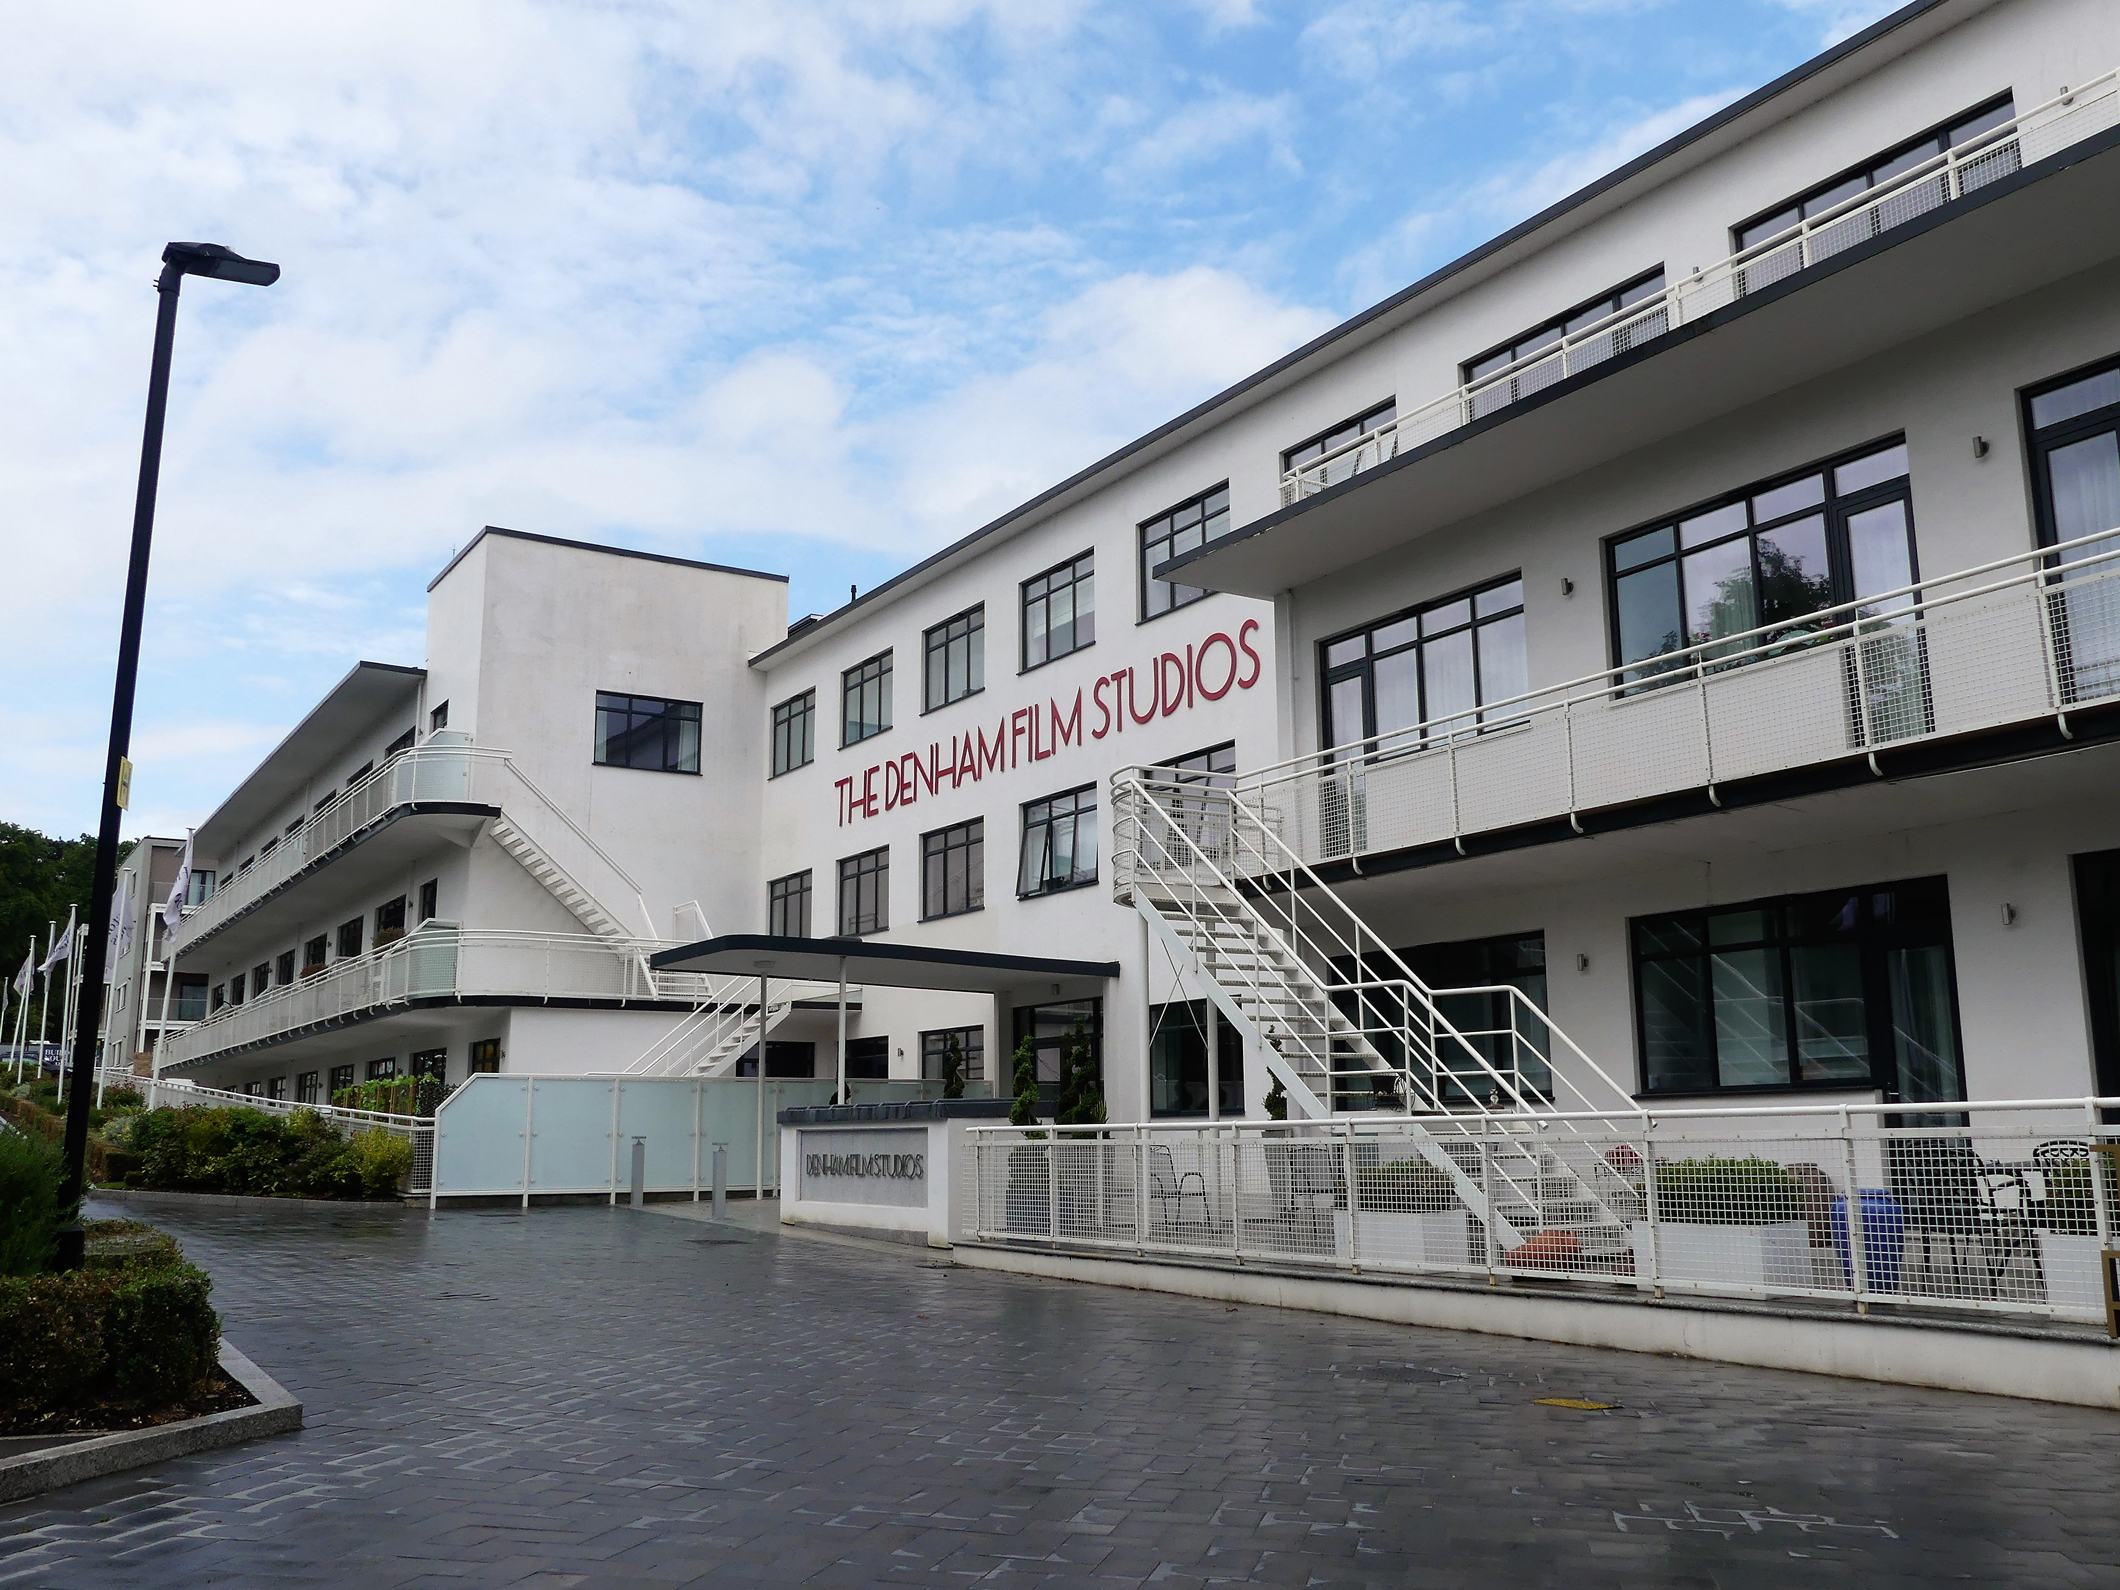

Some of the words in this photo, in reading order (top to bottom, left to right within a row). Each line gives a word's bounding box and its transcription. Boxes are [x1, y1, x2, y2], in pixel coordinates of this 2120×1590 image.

[834, 765, 880, 827] THE
[885, 715, 1005, 811] DENHAM
[1011, 686, 1082, 768] FILM
[1092, 618, 1261, 739] STUDIOS
